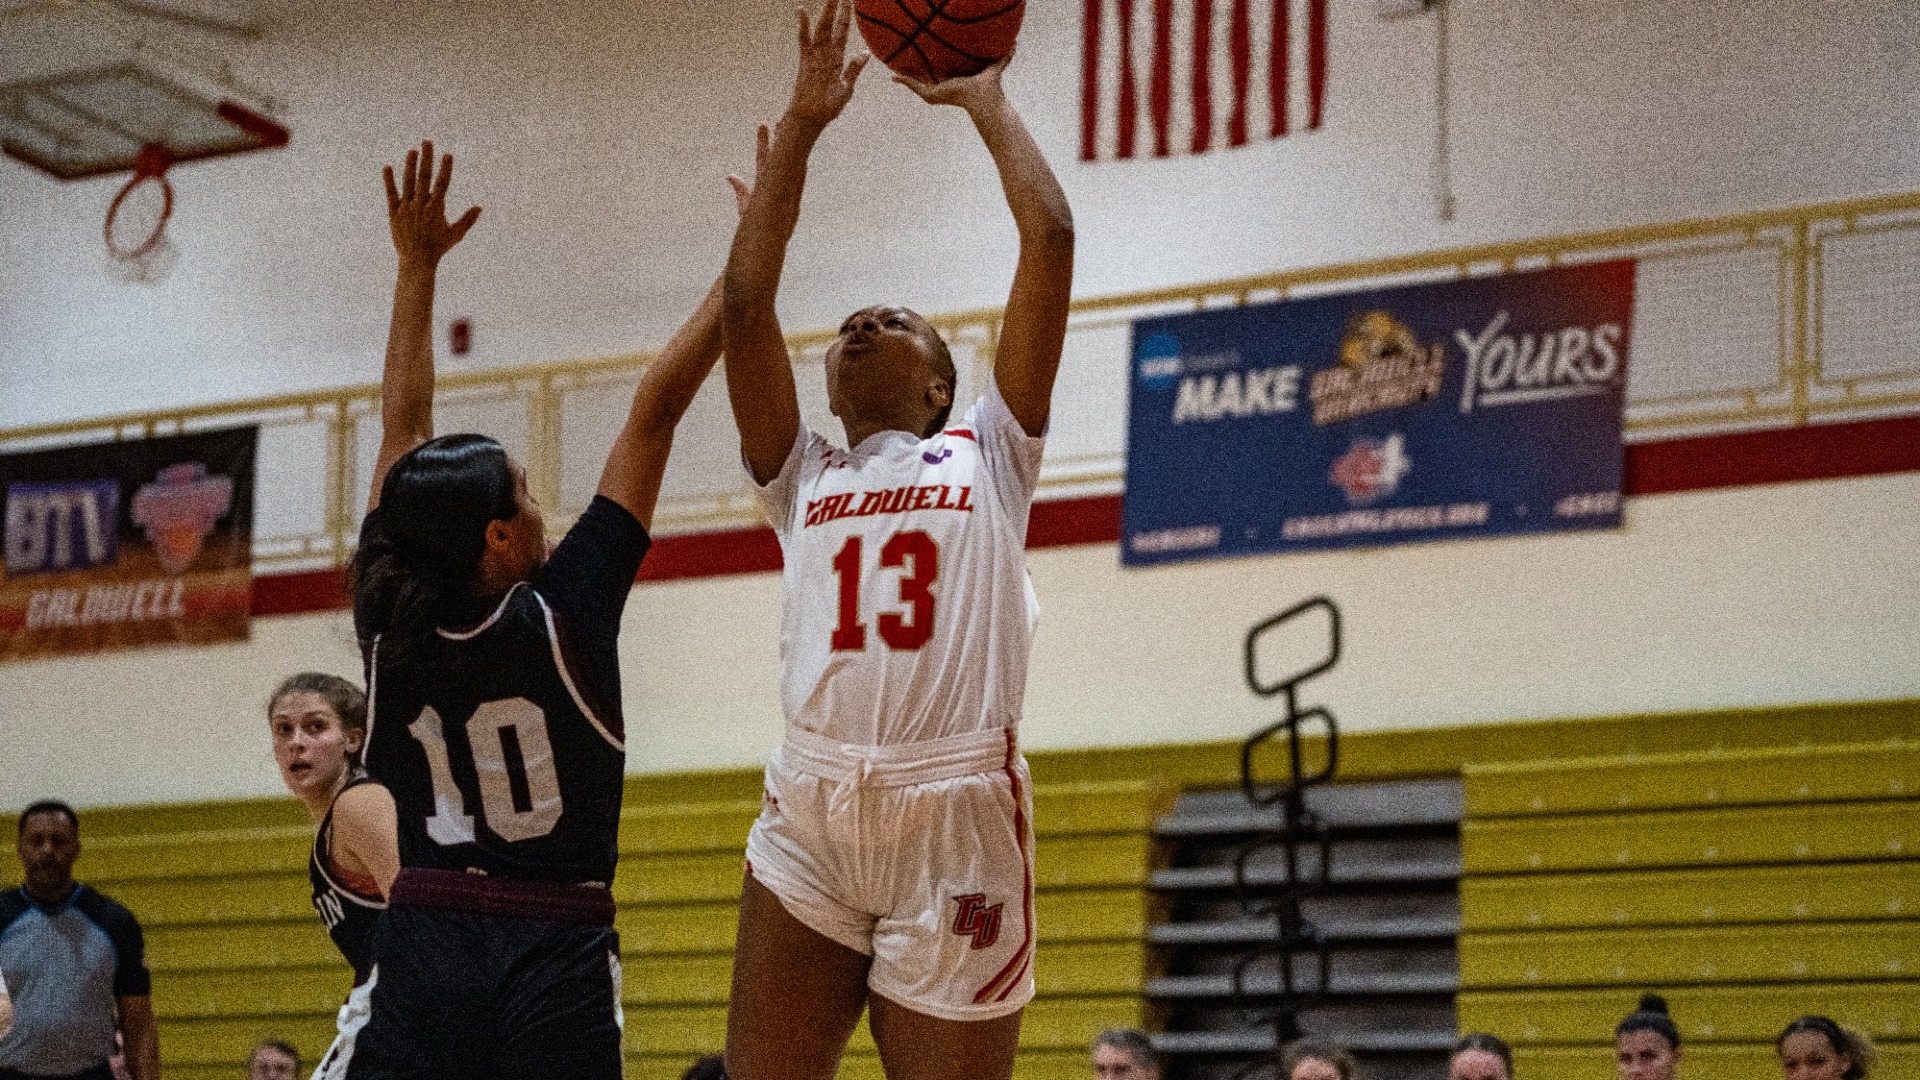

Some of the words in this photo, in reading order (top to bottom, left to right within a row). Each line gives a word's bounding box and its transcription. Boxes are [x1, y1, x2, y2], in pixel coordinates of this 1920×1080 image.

[1174, 365, 1302, 424] MAKE
[831, 530, 939, 651] 13
[407, 697, 563, 846] 10
